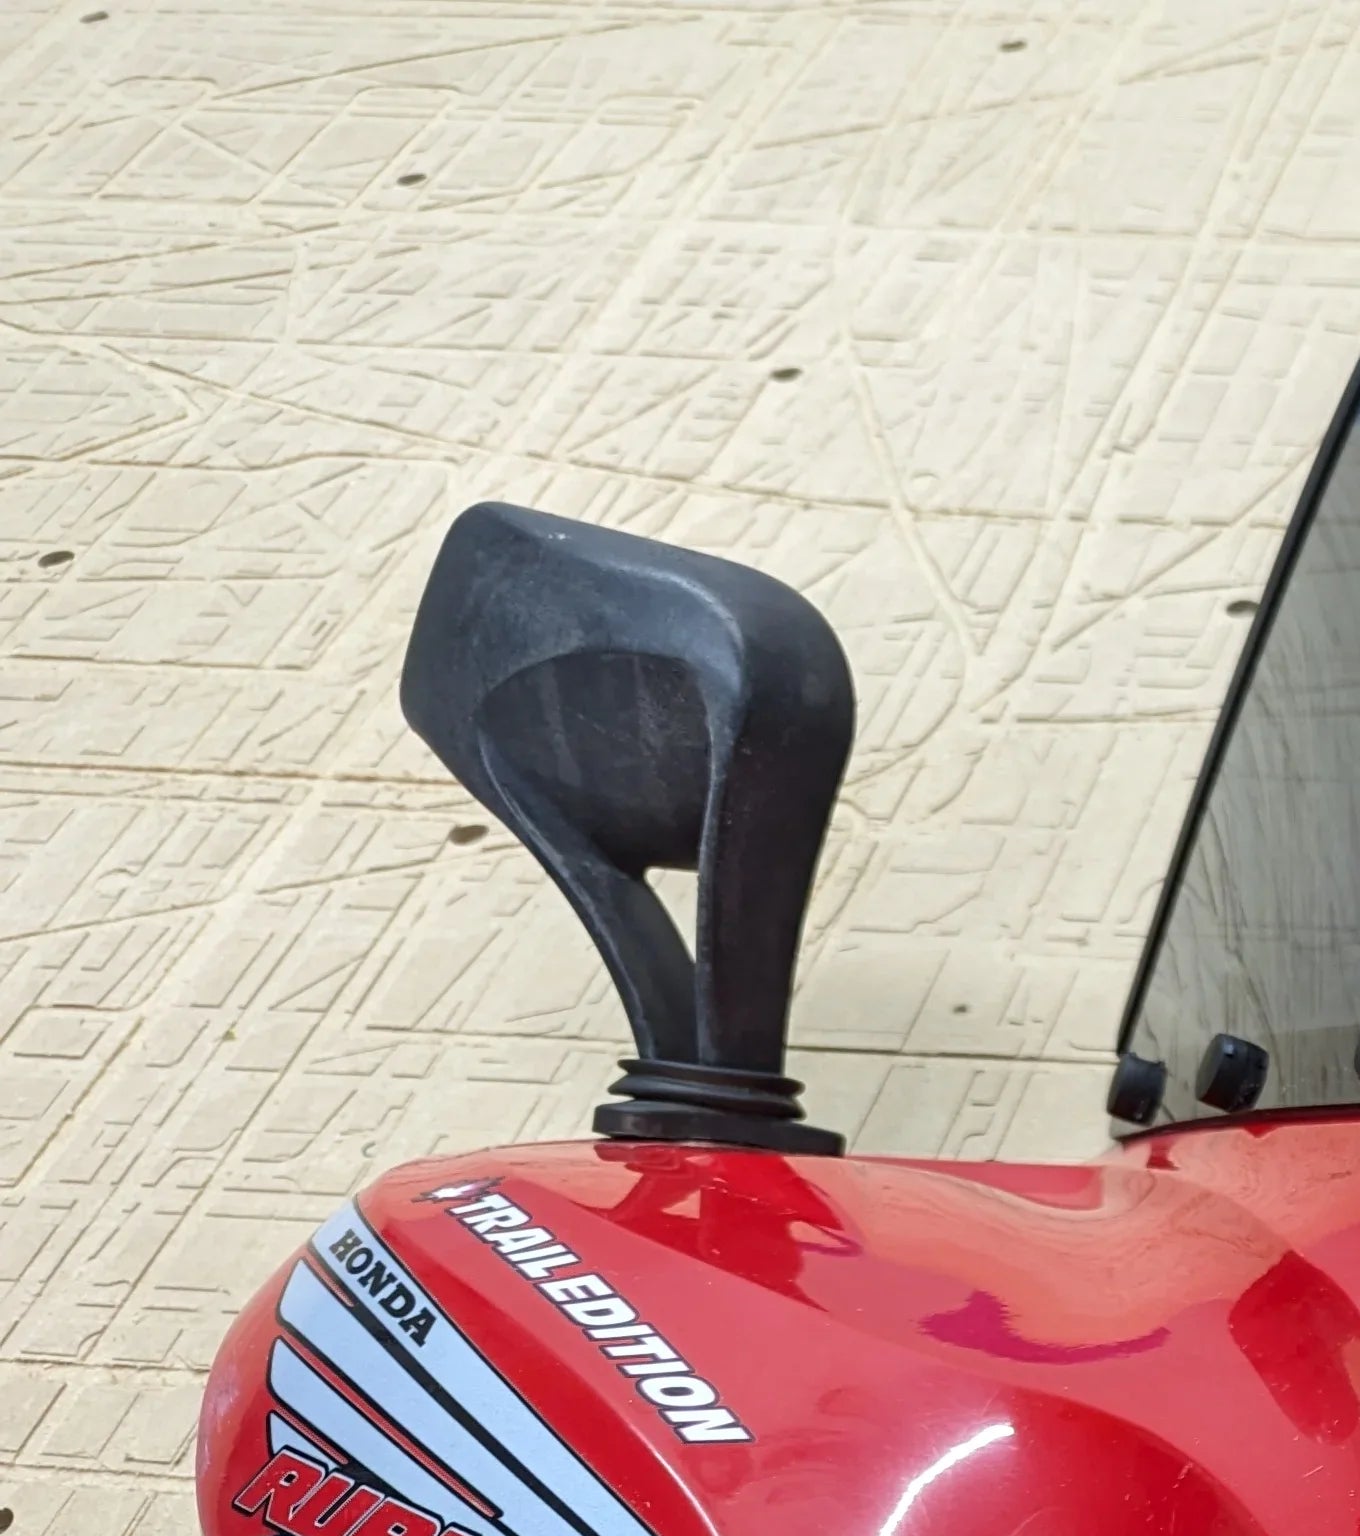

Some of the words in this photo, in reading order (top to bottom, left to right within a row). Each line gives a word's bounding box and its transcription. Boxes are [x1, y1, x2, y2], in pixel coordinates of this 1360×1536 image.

[328, 1228, 441, 1348] HONDA
[448, 1193, 580, 1280] TRAIL
[538, 1273, 756, 1444] EDITION
